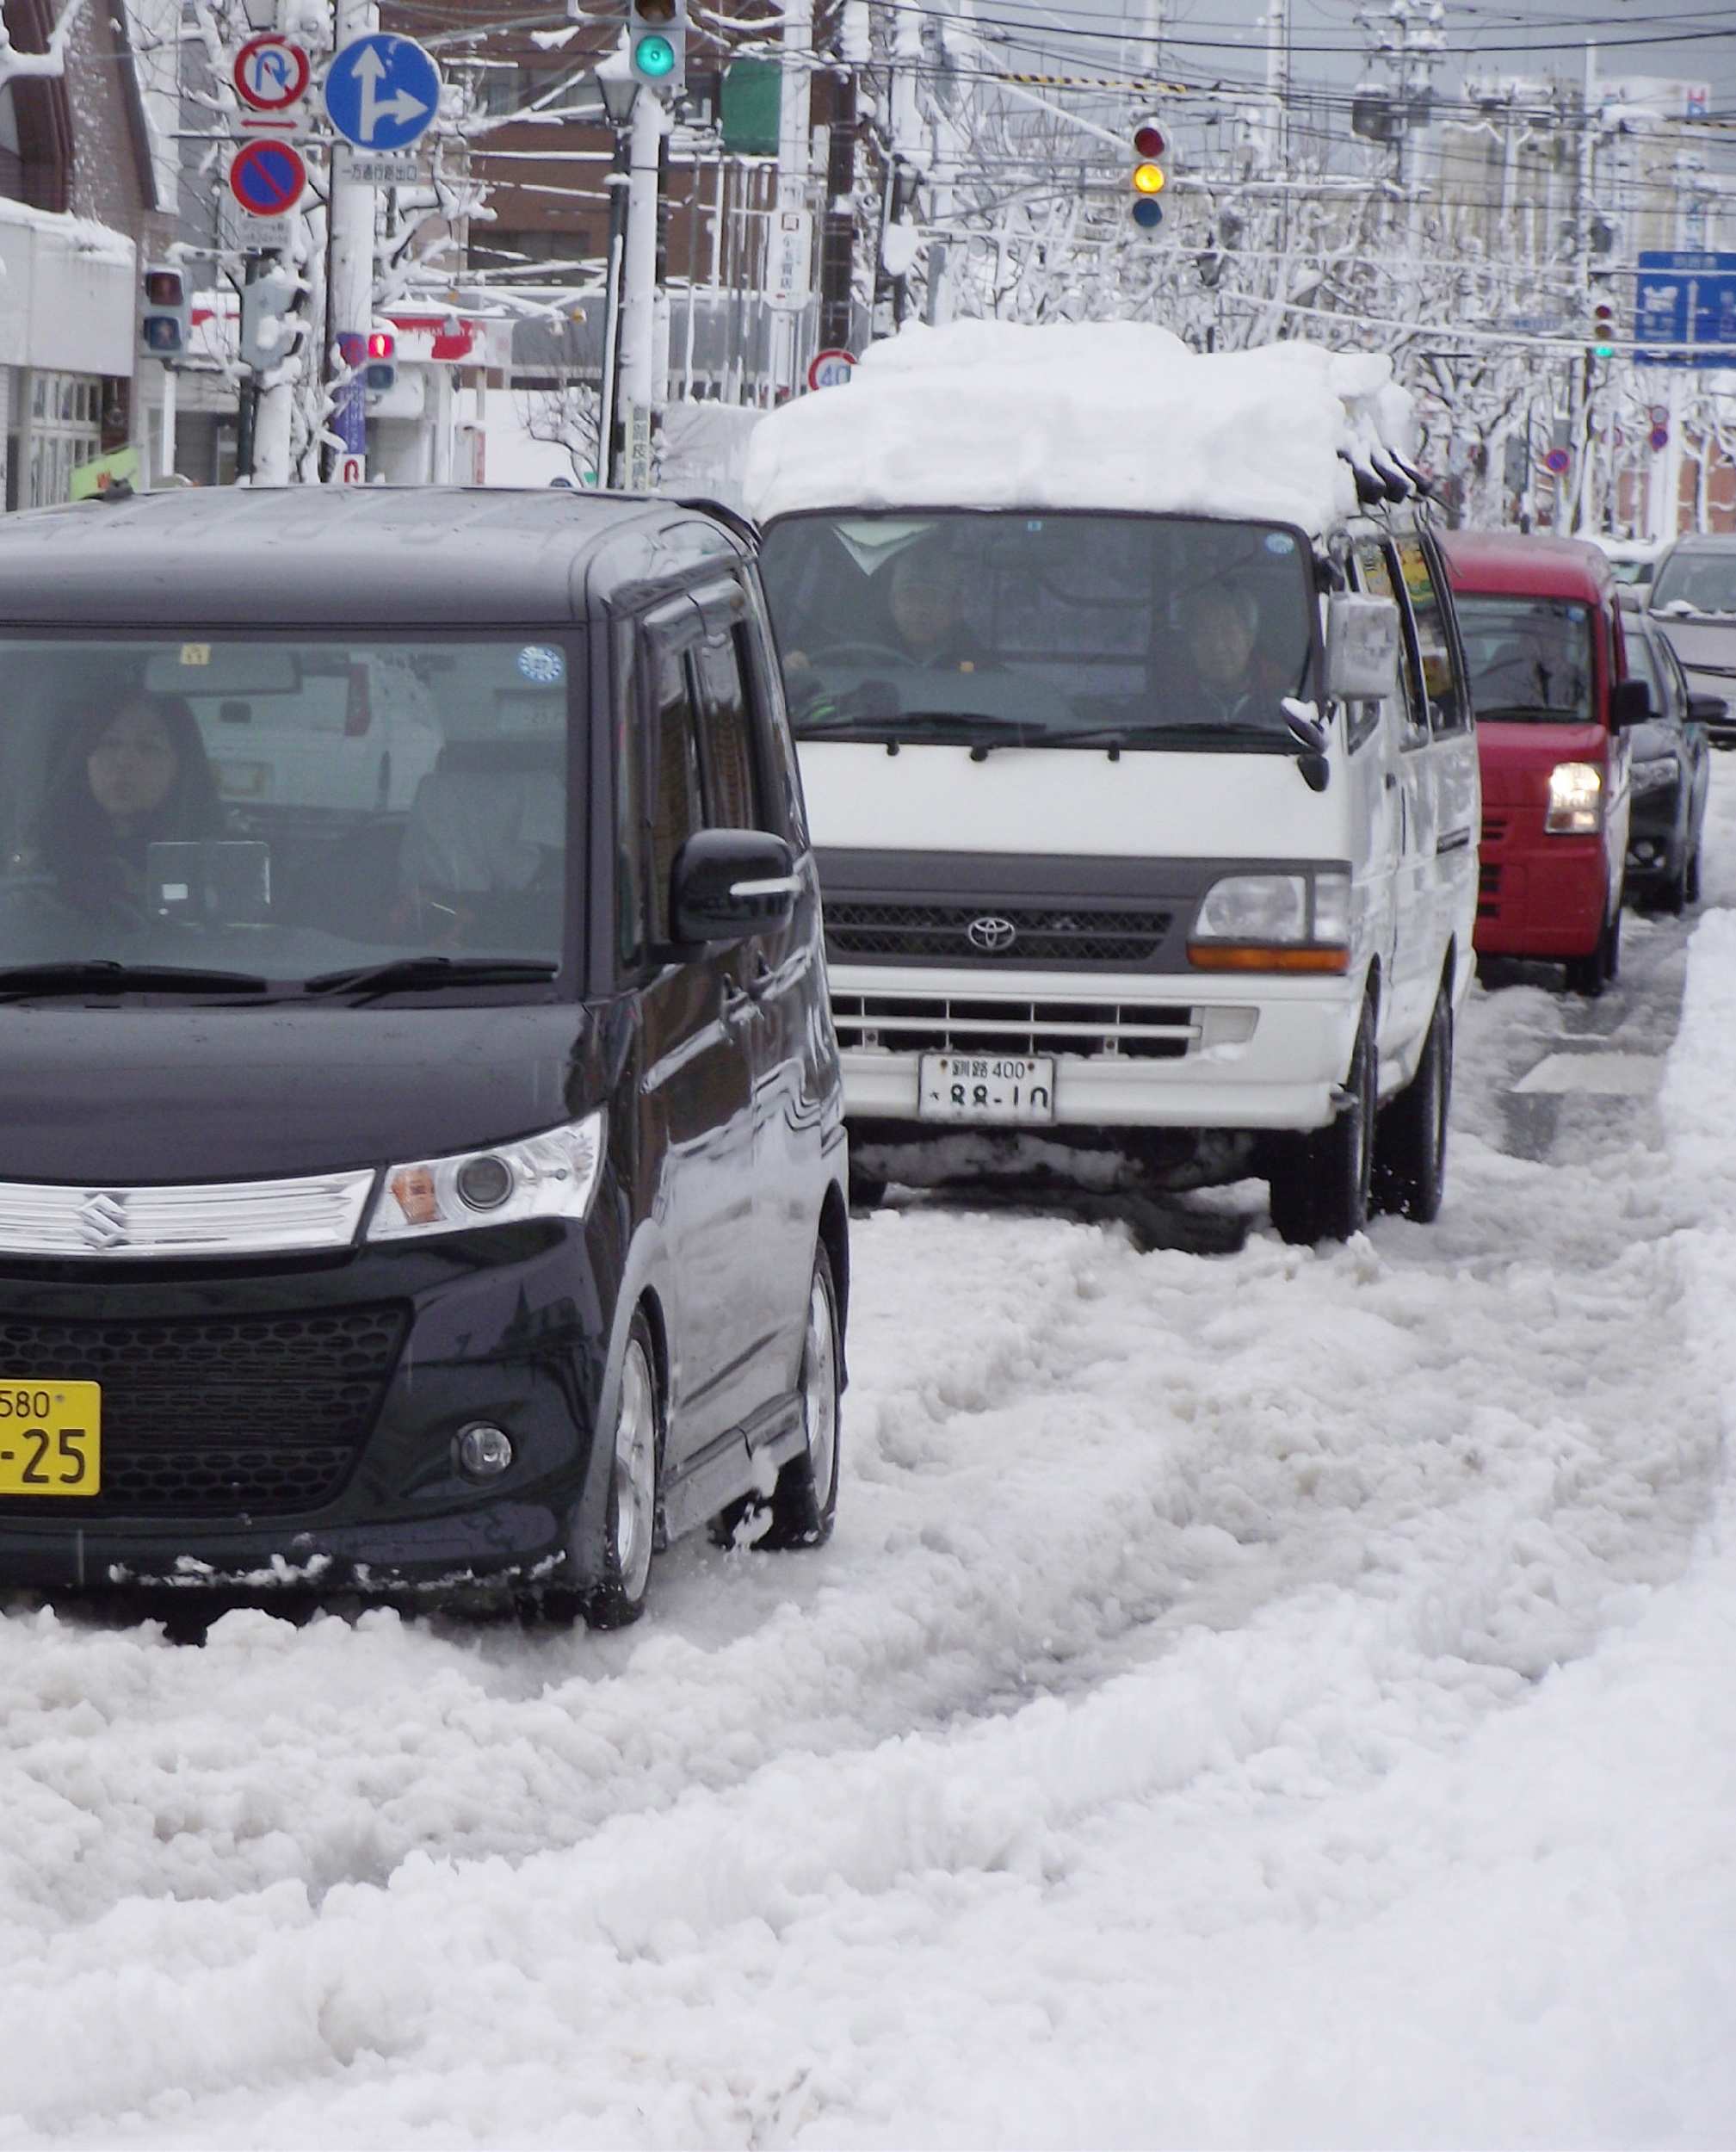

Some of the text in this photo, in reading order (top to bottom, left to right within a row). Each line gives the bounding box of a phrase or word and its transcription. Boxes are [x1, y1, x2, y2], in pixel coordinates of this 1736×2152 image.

[819, 364, 851, 386] 40
[992, 1061, 1026, 1079] 400
[0, 1390, 50, 1419] 580
